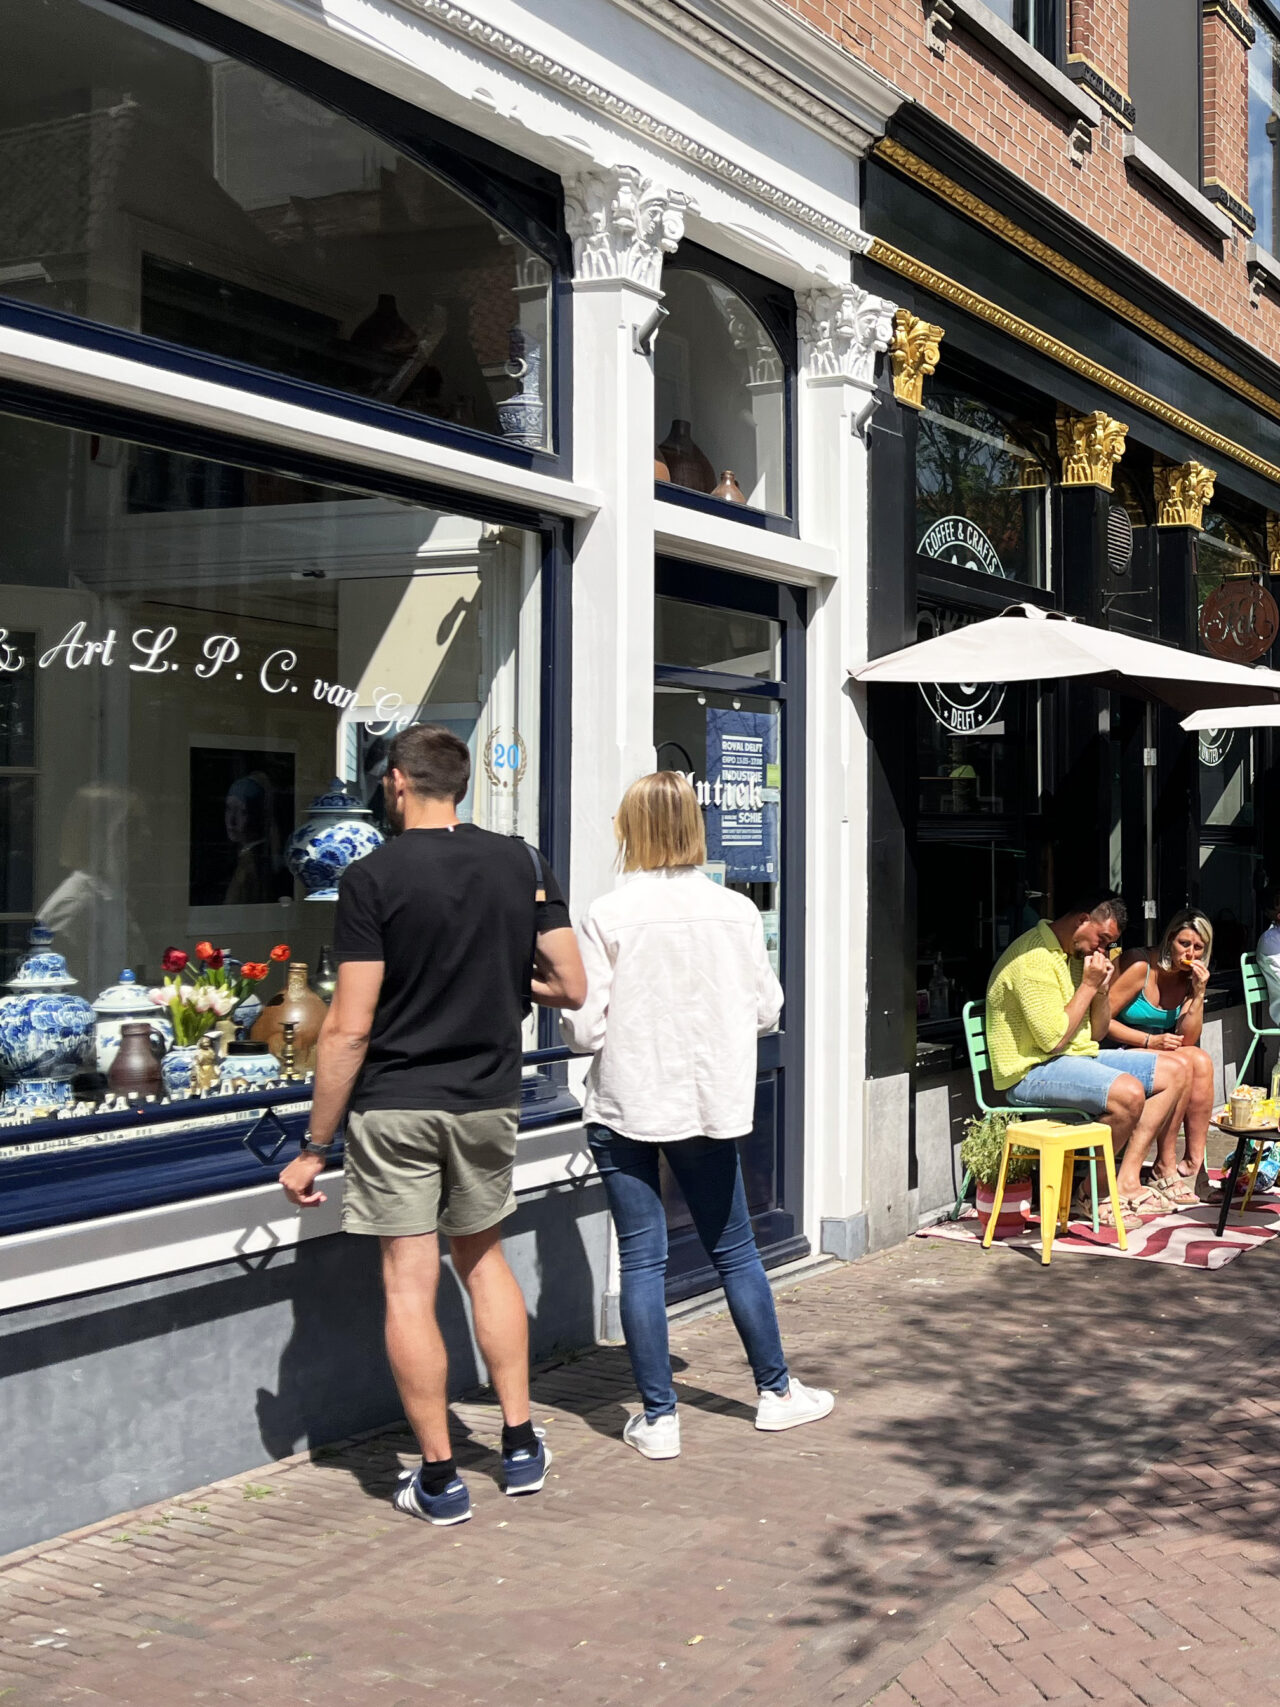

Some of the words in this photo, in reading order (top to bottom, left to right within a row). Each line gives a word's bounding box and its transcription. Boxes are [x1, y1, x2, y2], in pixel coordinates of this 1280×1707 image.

[925, 521, 955, 557] COFFEE
[957, 522, 965, 540] &
[966, 526, 998, 574] CRAFTS
[38, 621, 118, 669] Art
[129, 626, 179, 673] L.
[195, 635, 244, 681] P.
[259, 649, 299, 695] C.
[313, 677, 360, 712] van
[950, 709, 976, 730] DELFT
[494, 743, 519, 769] 20
[722, 741, 744, 752] ROYAL
[744, 742, 763, 753] DELFT
[738, 812, 763, 823] SCHIE
